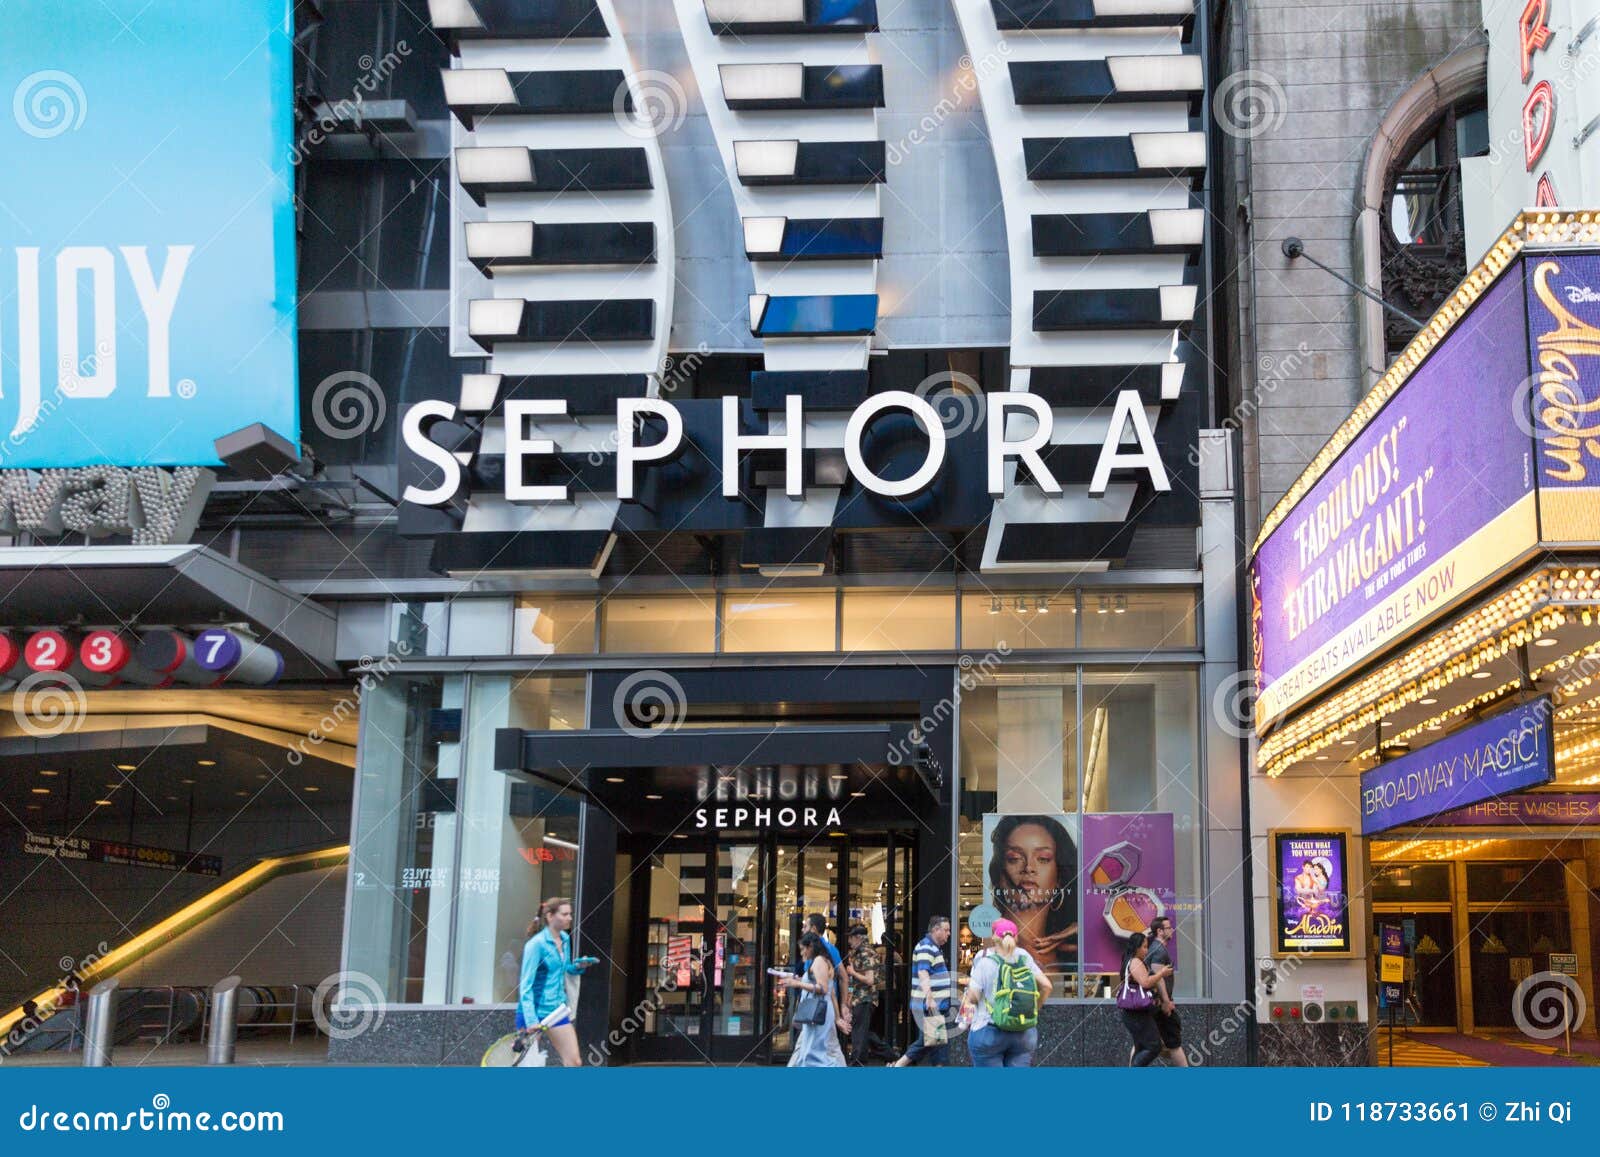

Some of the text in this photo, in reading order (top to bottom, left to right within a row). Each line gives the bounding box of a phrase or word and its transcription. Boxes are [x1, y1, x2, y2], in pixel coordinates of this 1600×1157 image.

[402, 389, 1172, 506] SEPHORA
[1365, 540, 1427, 600] THE NEW YORK TIMES
[1276, 560, 1456, 705] GREAT SEATS AVAILABLE NOW
[35, 635, 226, 665] 2 3 7
[695, 807, 842, 828] SEPHORA
[1467, 801, 1519, 817] THREE
[59, 847, 88, 860] Station
[1030, 887, 1072, 896] BEAUTY
[1086, 887, 1121, 896] FENTY
[1284, 913, 1343, 935] Aladdin
